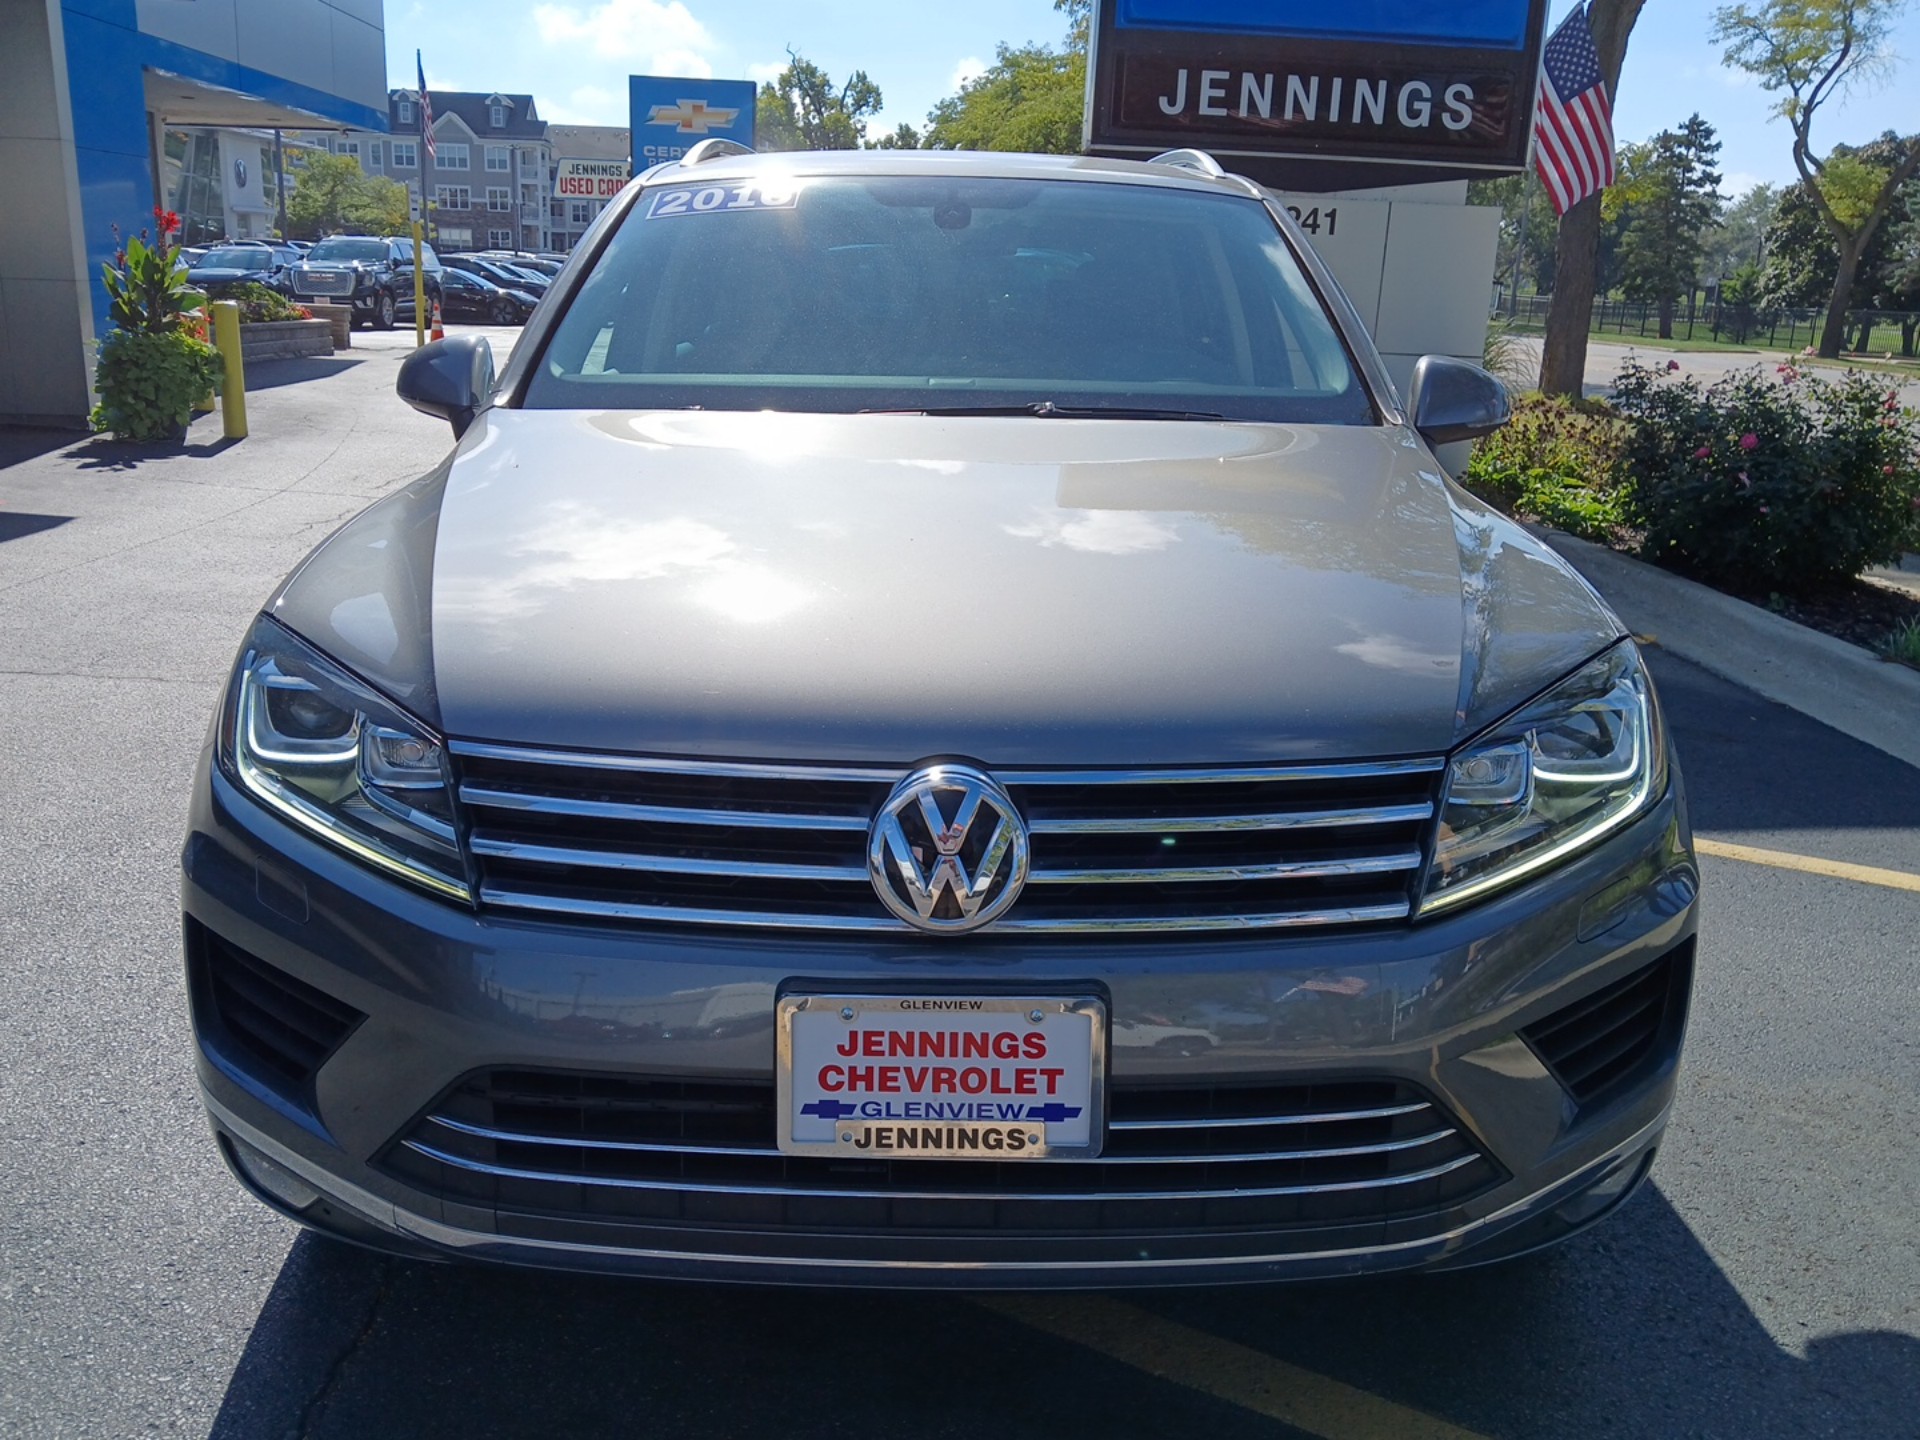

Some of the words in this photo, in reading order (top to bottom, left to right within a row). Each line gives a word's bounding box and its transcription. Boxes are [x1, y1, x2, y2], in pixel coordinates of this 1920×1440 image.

[1158, 68, 1475, 131] JENNINGS
[568, 163, 622, 177] JENNINGS
[560, 177, 594, 195] USED
[598, 179, 630, 196] CAR
[899, 1000, 984, 1010] GLENVIEW
[836, 1030, 1048, 1059] JENNINGS
[817, 1064, 1065, 1095] CHEVROLET
[859, 1101, 1026, 1120] GLENVIEW
[854, 1127, 1027, 1150] JENNINGS
